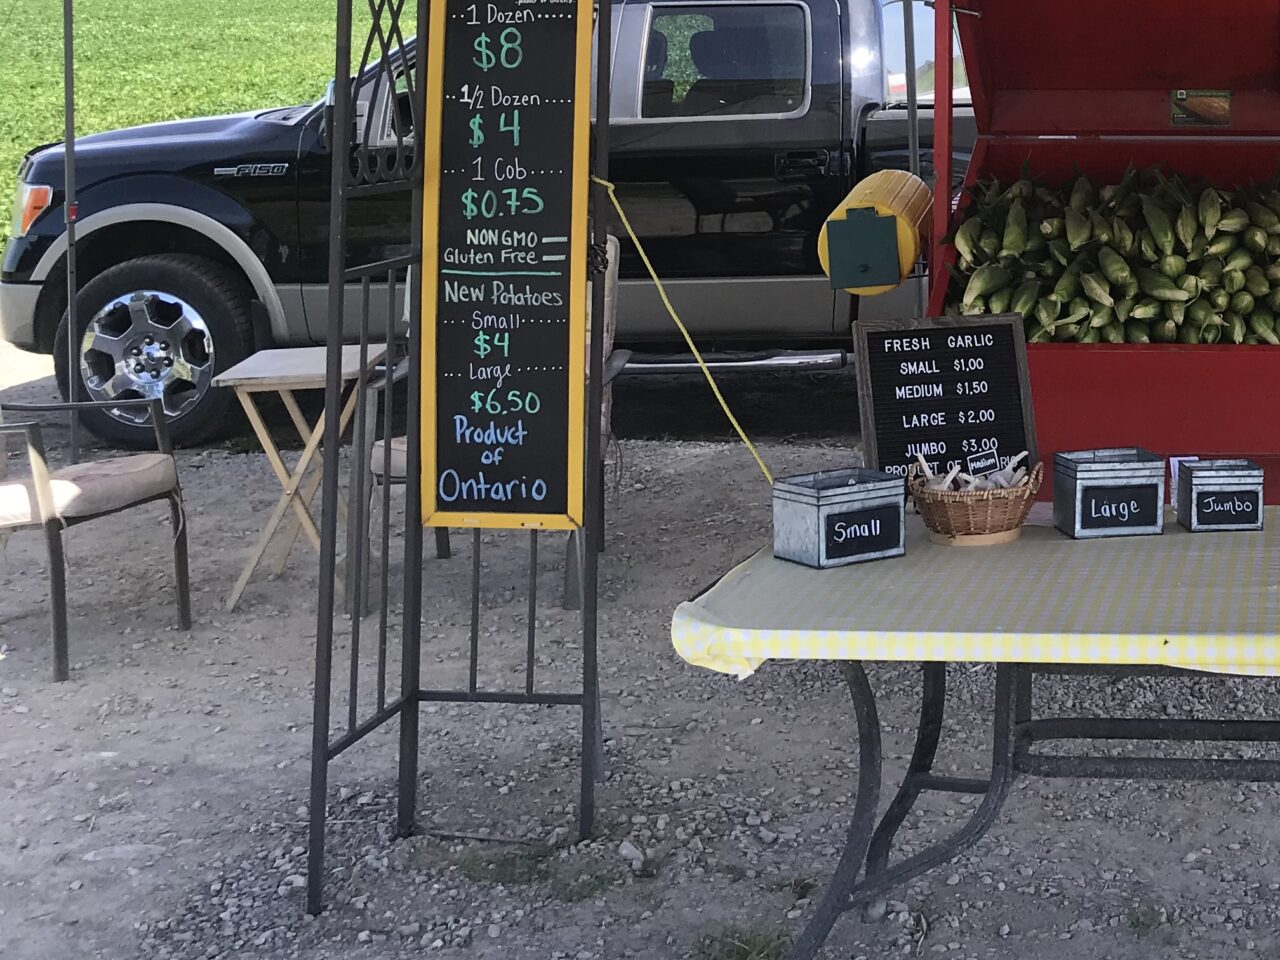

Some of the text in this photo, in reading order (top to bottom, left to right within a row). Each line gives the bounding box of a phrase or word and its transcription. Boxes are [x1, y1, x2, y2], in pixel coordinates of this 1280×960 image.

[466, 4, 535, 25] 1 Dozen
[472, 26, 523, 72] $8
[459, 84, 540, 110] 1/2 Dozen
[471, 157, 526, 181] 1 Cob
[461, 188, 545, 219] $0.75
[501, 230, 538, 247] GMO
[443, 249, 539, 265] Gluten Free
[444, 280, 563, 306] New Potatoes
[471, 310, 521, 329] Small
[473, 330, 510, 359] $4
[884, 334, 994, 352] FRESH GARLIC
[469, 362, 512, 388] Large
[900, 358, 984, 375] SMALL $1.00
[470, 388, 541, 415] $6.50
[895, 381, 988, 399] MEDIUM $1.50
[453, 414, 528, 446] Product
[902, 409, 995, 428] LARGE $2.00
[480, 447, 504, 466] of
[905, 437, 998, 458] JUMBO $3.00
[438, 468, 547, 502] Ontario
[1090, 498, 1141, 521] Large
[1202, 497, 1254, 515] Jumbo
[834, 519, 881, 543] Small
